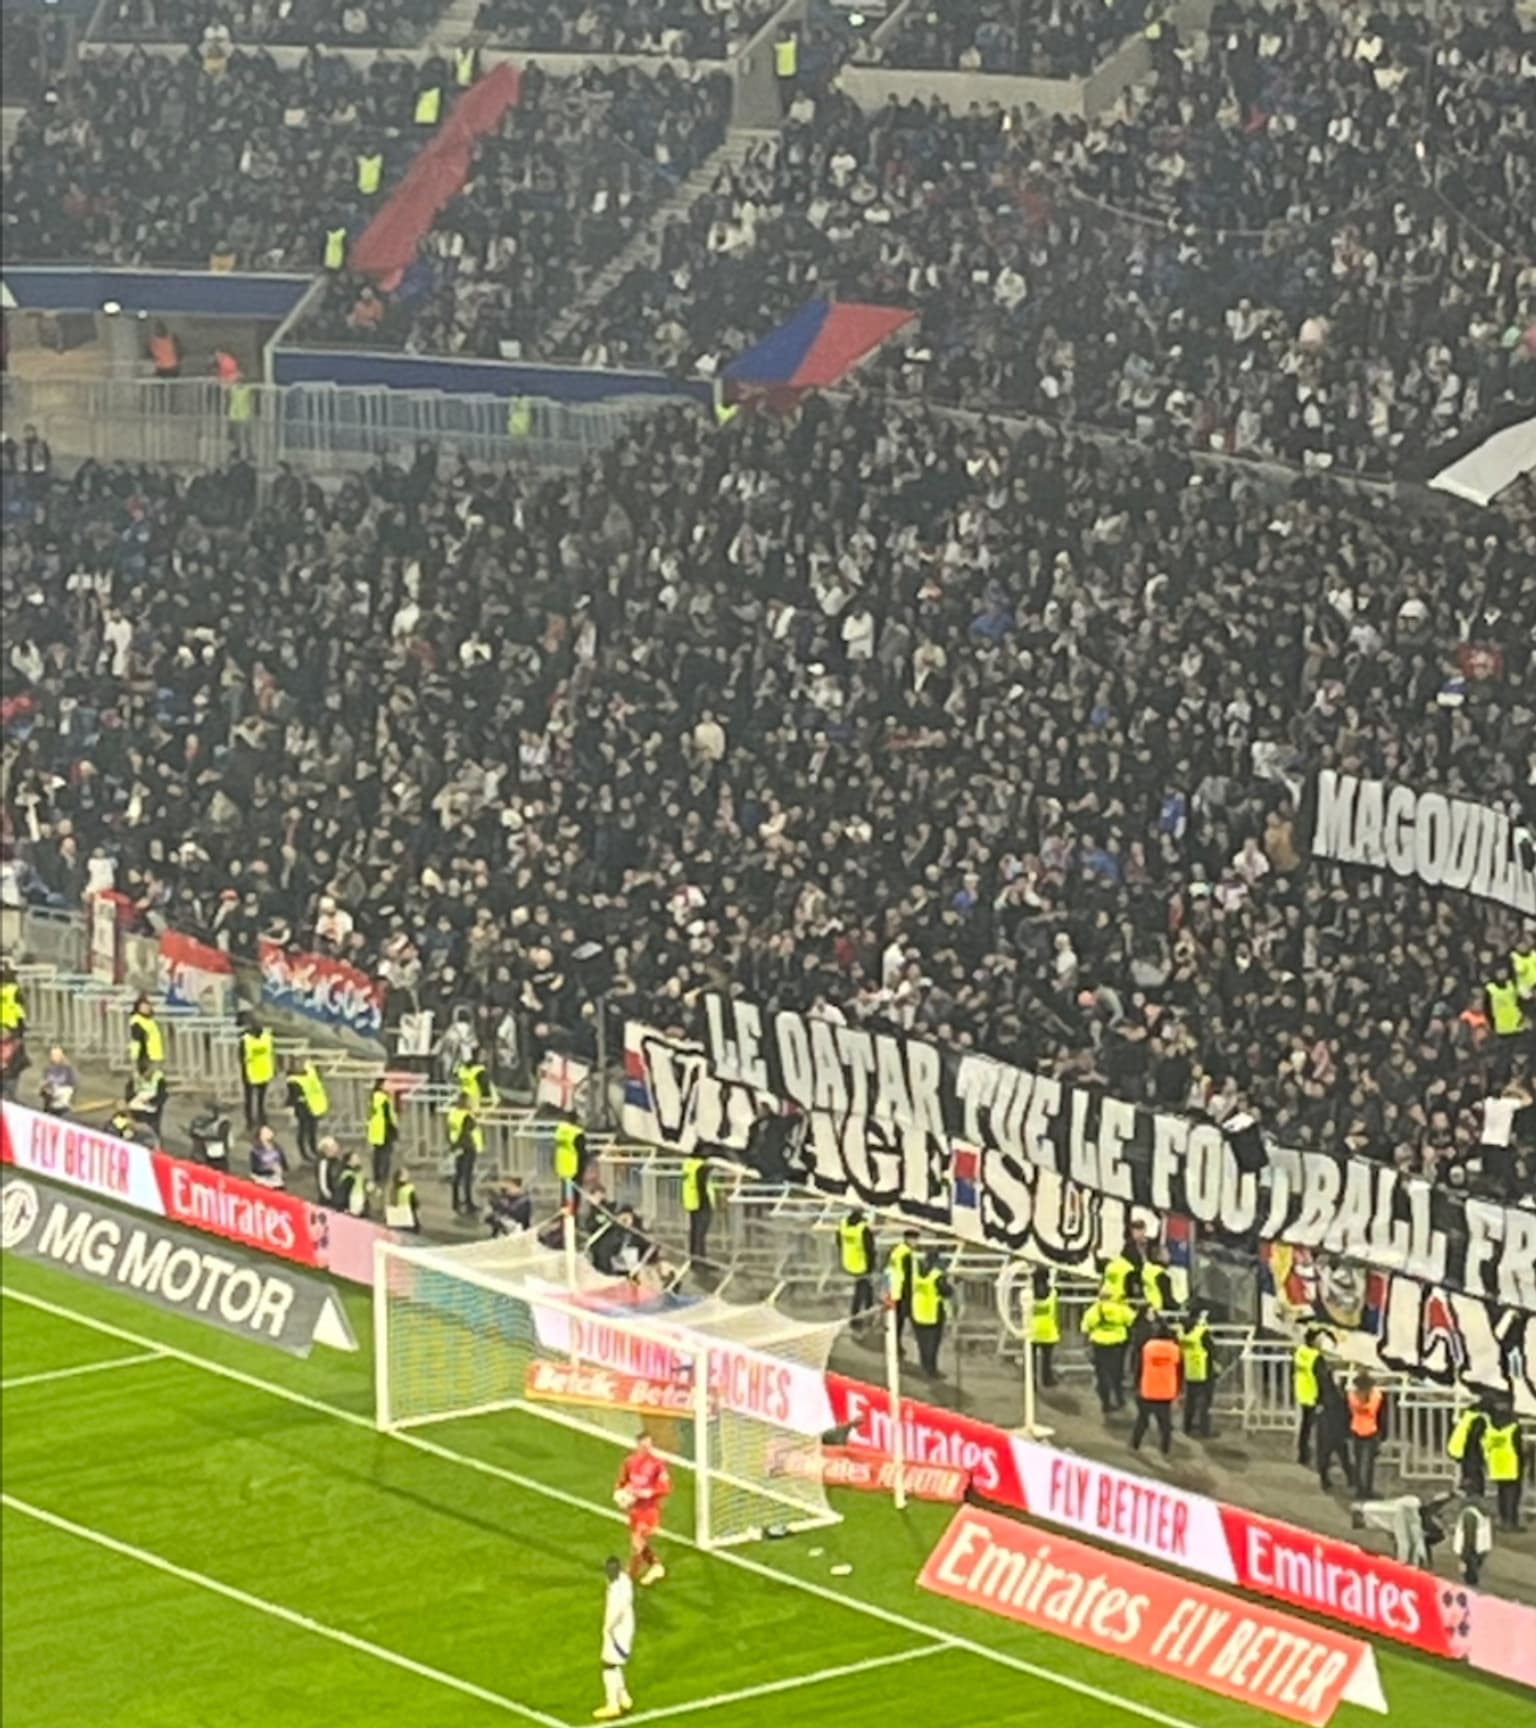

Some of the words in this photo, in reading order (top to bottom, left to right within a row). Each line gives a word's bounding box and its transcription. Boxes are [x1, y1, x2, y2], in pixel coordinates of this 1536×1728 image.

[30, 1117, 61, 1170] FLY
[63, 1130, 130, 1194] BETTER
[705, 993, 769, 1091] LE
[955, 1054, 1062, 1171] TUE
[1070, 1088, 1137, 1200] LE
[1151, 1112, 1447, 1283] FOOTBALL
[169, 1167, 296, 1250] Emirates
[37, 1203, 122, 1276] MG
[117, 1229, 295, 1337] MOTOR
[704, 1345, 792, 1421] EACHES
[845, 1389, 1000, 1489] Emirates
[1048, 1458, 1091, 1527] FLY
[1096, 1476, 1189, 1557] BETTER
[936, 1521, 1151, 1644] Emirates
[1150, 1598, 1231, 1667] FLY
[1208, 1618, 1348, 1712] BETTER
[1246, 1523, 1421, 1635] Emirates
